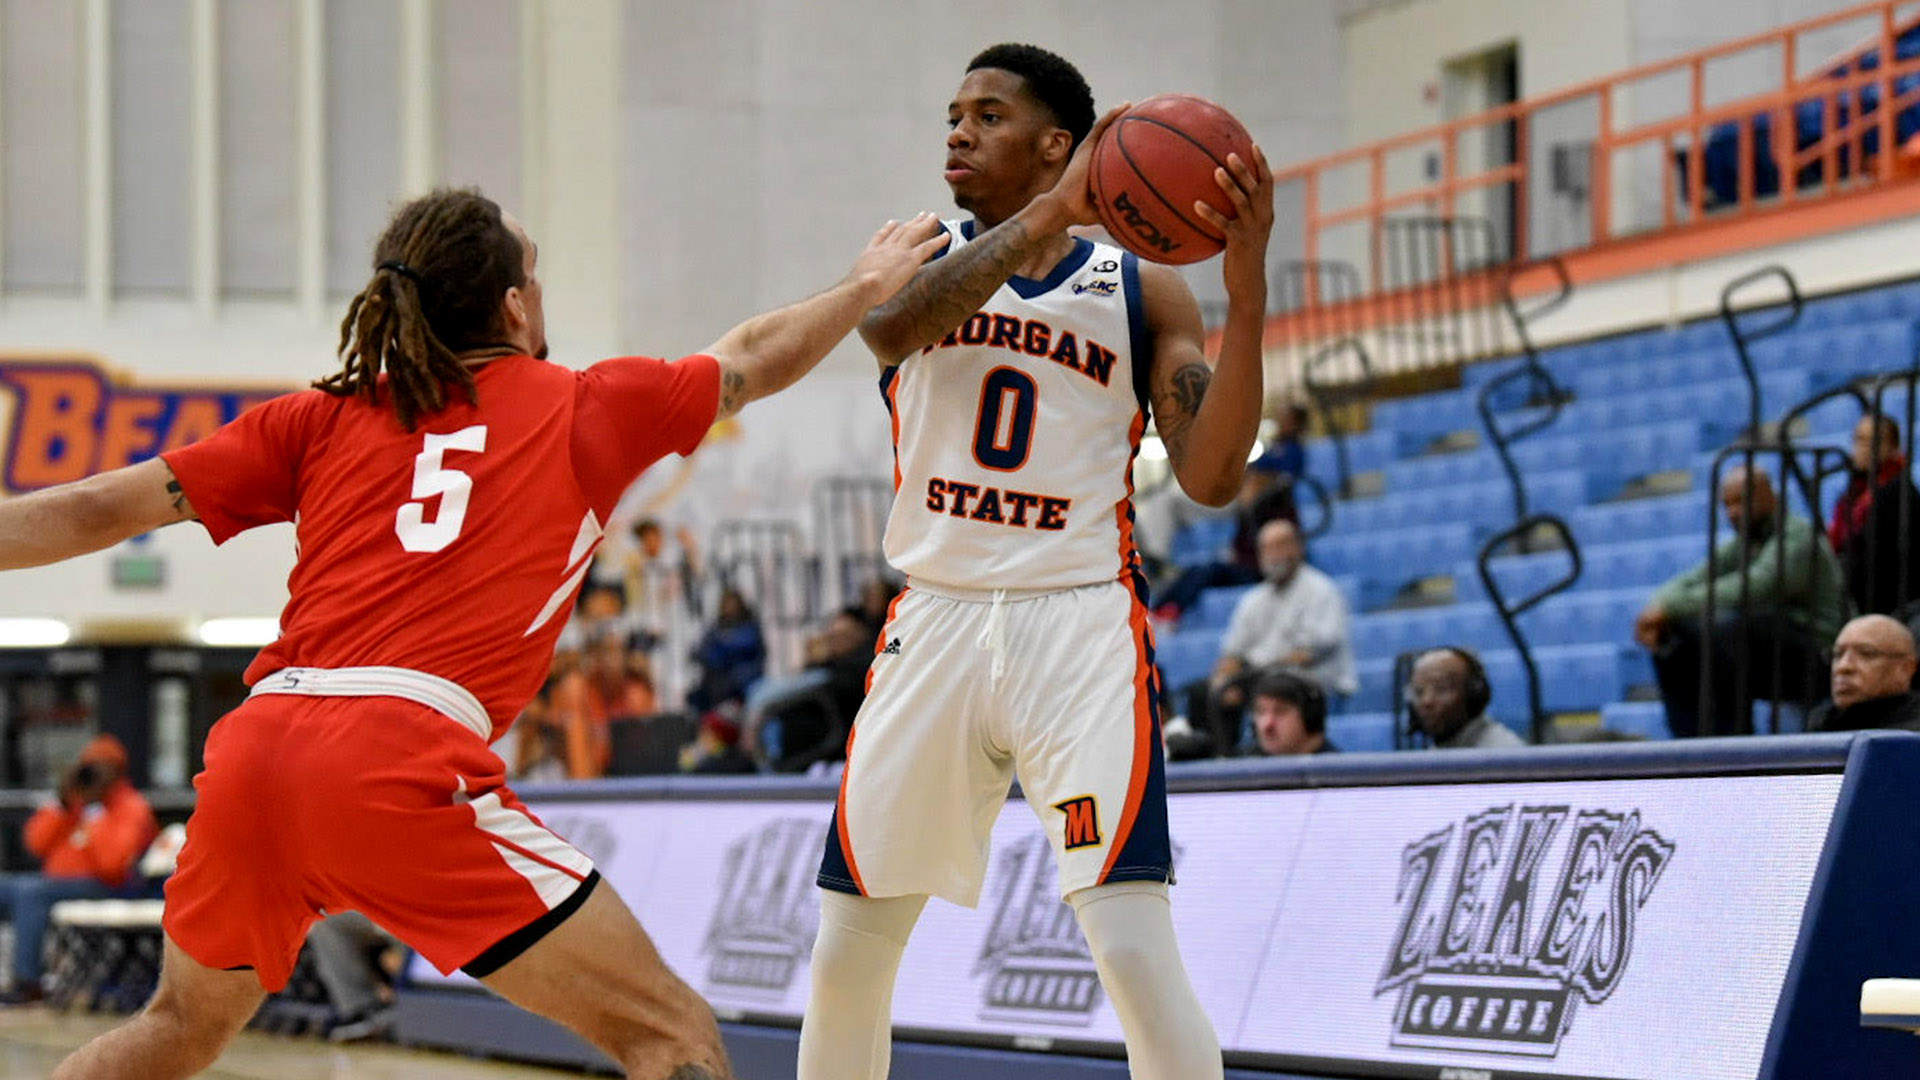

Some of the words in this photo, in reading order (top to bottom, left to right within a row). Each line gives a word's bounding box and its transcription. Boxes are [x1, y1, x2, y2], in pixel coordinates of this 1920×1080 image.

[1113, 191, 1182, 253] NCAA
[923, 311, 1117, 387] ORGAN
[3, 366, 262, 484] BEA
[971, 364, 1039, 473] 0
[395, 425, 487, 553] 5
[926, 477, 1071, 530] STATE
[1052, 795, 1102, 851] M
[1374, 802, 1676, 1004] ZEKE'S
[1409, 994, 1552, 1035] COFFEE
